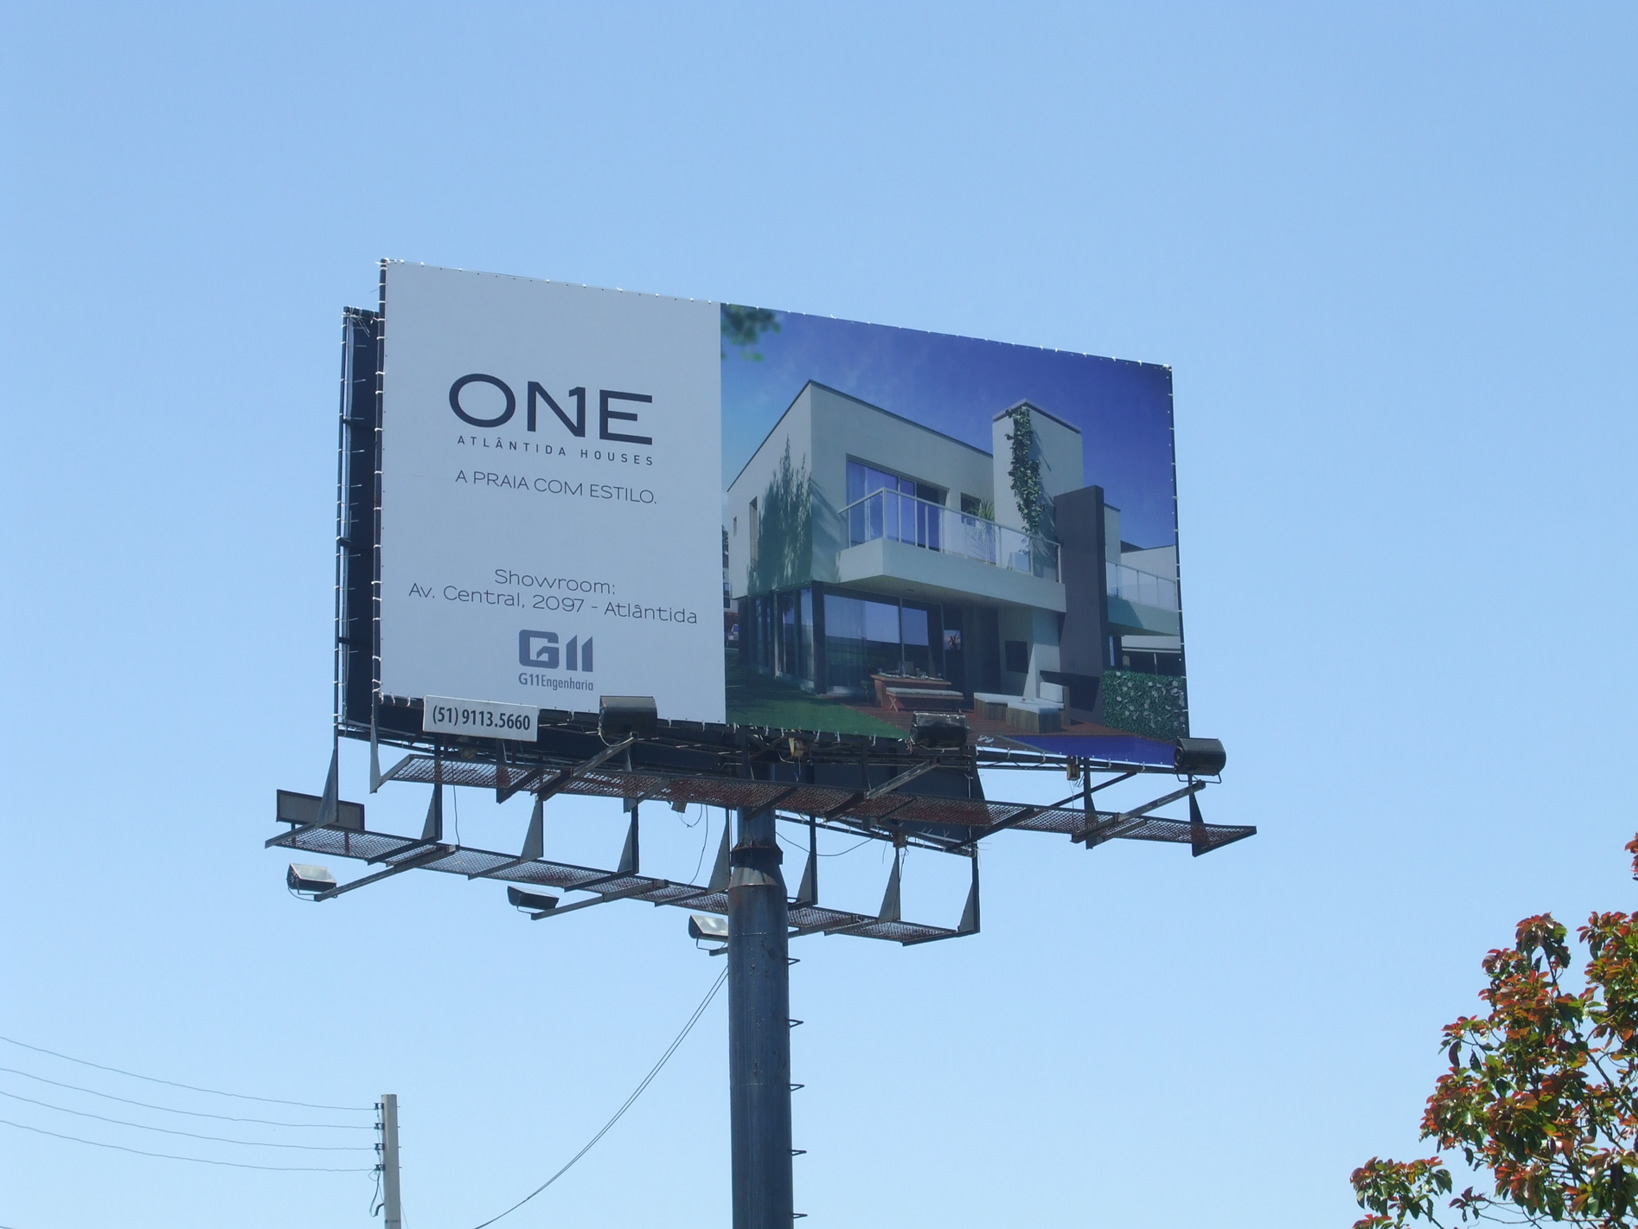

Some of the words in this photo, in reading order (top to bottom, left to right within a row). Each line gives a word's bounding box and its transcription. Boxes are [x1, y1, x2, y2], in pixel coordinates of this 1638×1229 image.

[457, 435, 566, 456] ATLÂNTIDA
[580, 448, 653, 466] HOUSES
[455, 470, 467, 483] A
[473, 471, 529, 490] PRAIA
[533, 478, 583, 496] COM
[590, 484, 657, 504] ESTILO.
[494, 568, 615, 595] Showroom:
[408, 582, 435, 599] Av.
[443, 585, 525, 609] Central,
[532, 595, 585, 613] 2097
[603, 601, 697, 624] Atlântida
[518, 629, 593, 673] G11
